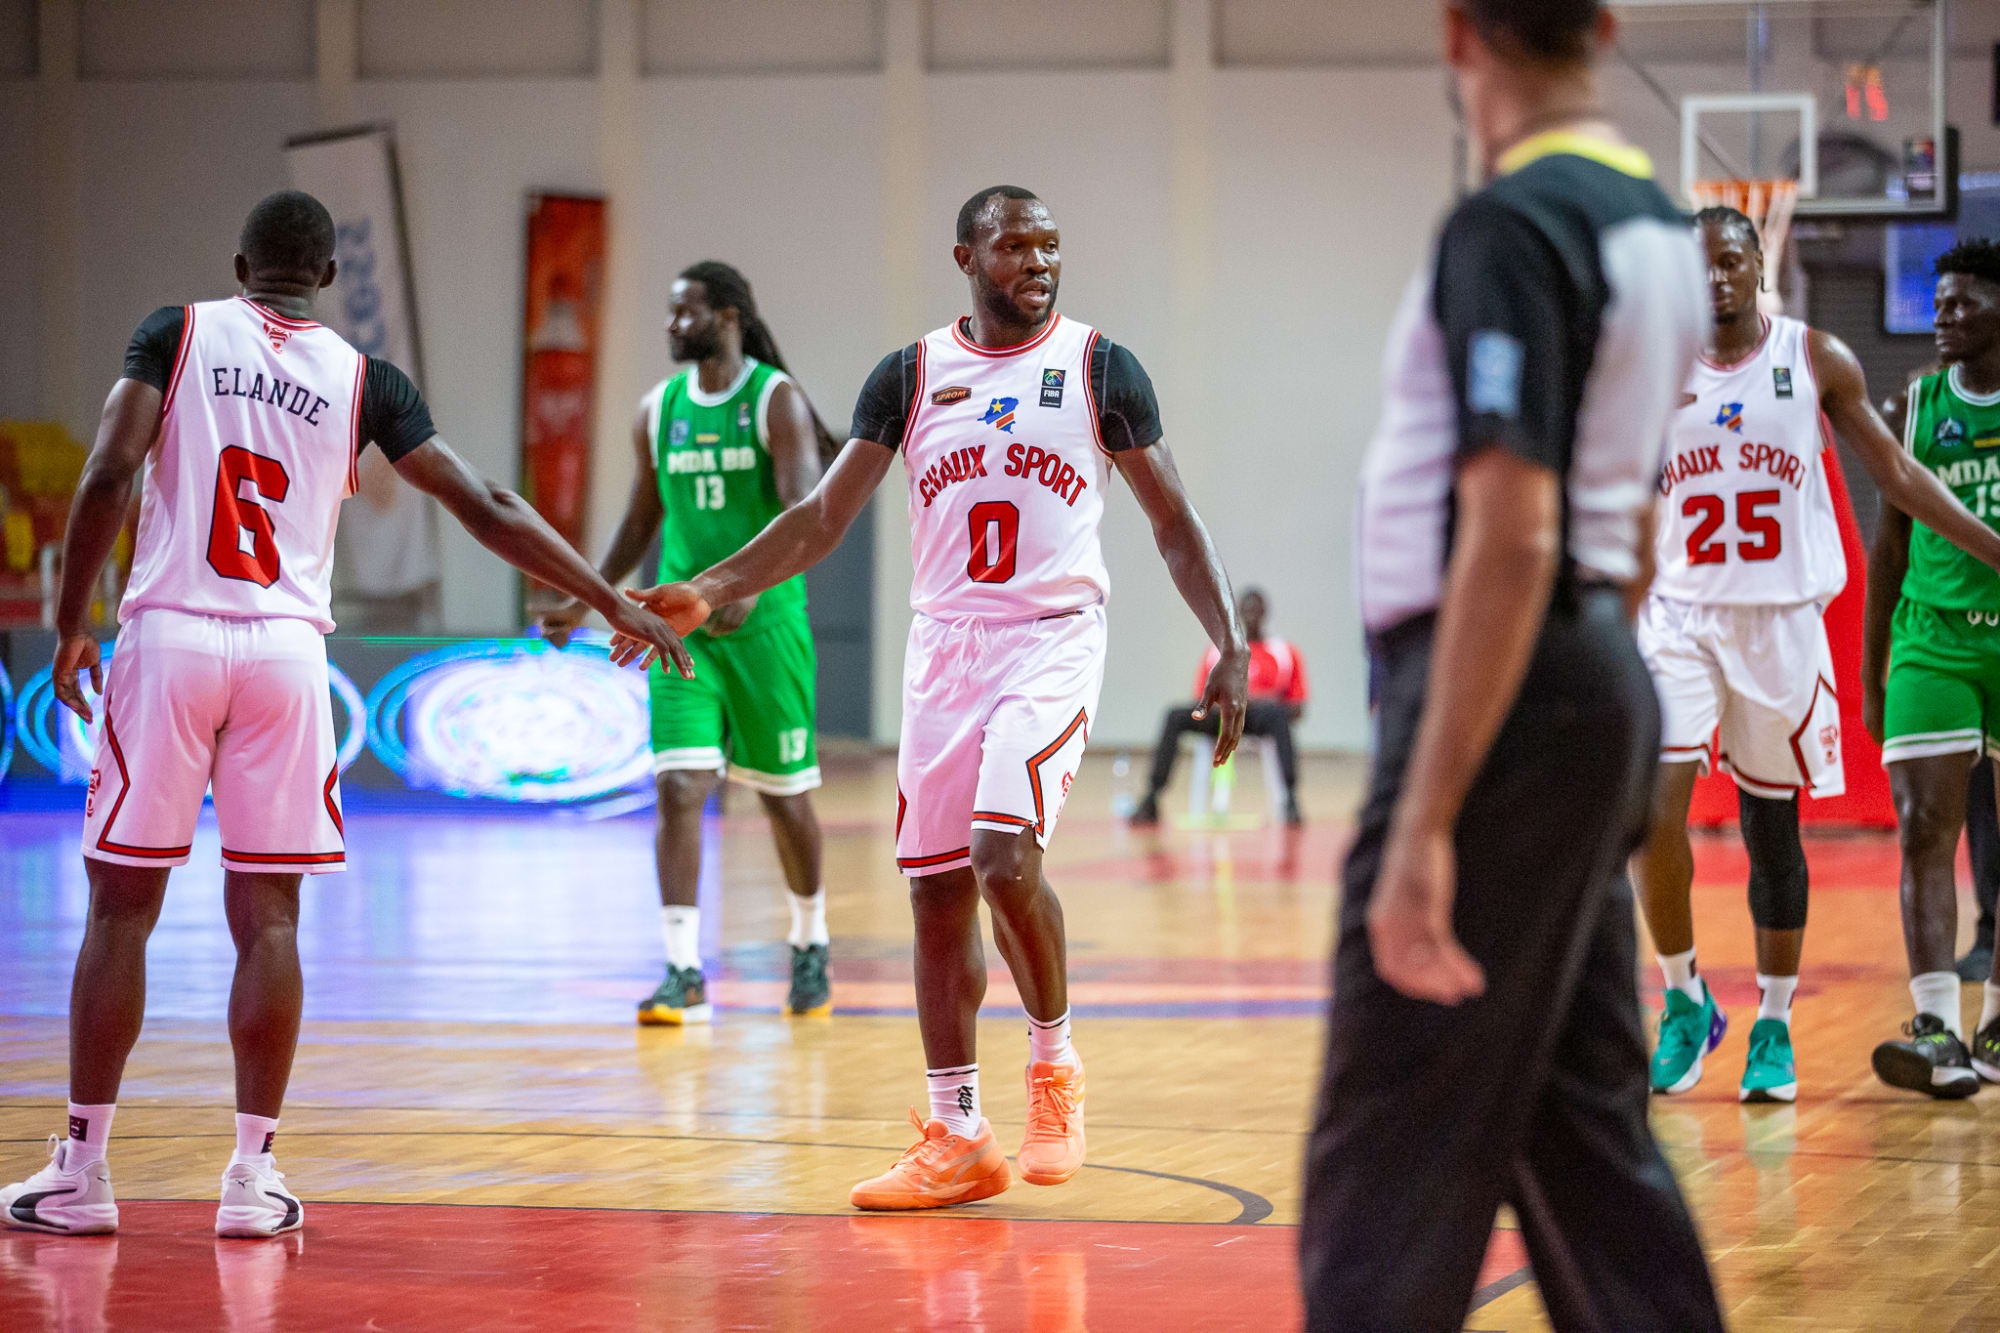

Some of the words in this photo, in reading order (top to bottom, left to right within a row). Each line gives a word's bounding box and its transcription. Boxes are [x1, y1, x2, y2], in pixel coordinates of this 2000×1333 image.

[212, 367, 330, 427] ELANDE
[695, 474, 725, 510] 13
[919, 444, 988, 508] CHAUX
[1004, 442, 1088, 508] SPORT
[206, 444, 290, 588] 6
[967, 500, 1020, 584] 0
[1681, 489, 1782, 567] 25
[778, 727, 808, 764] 13
